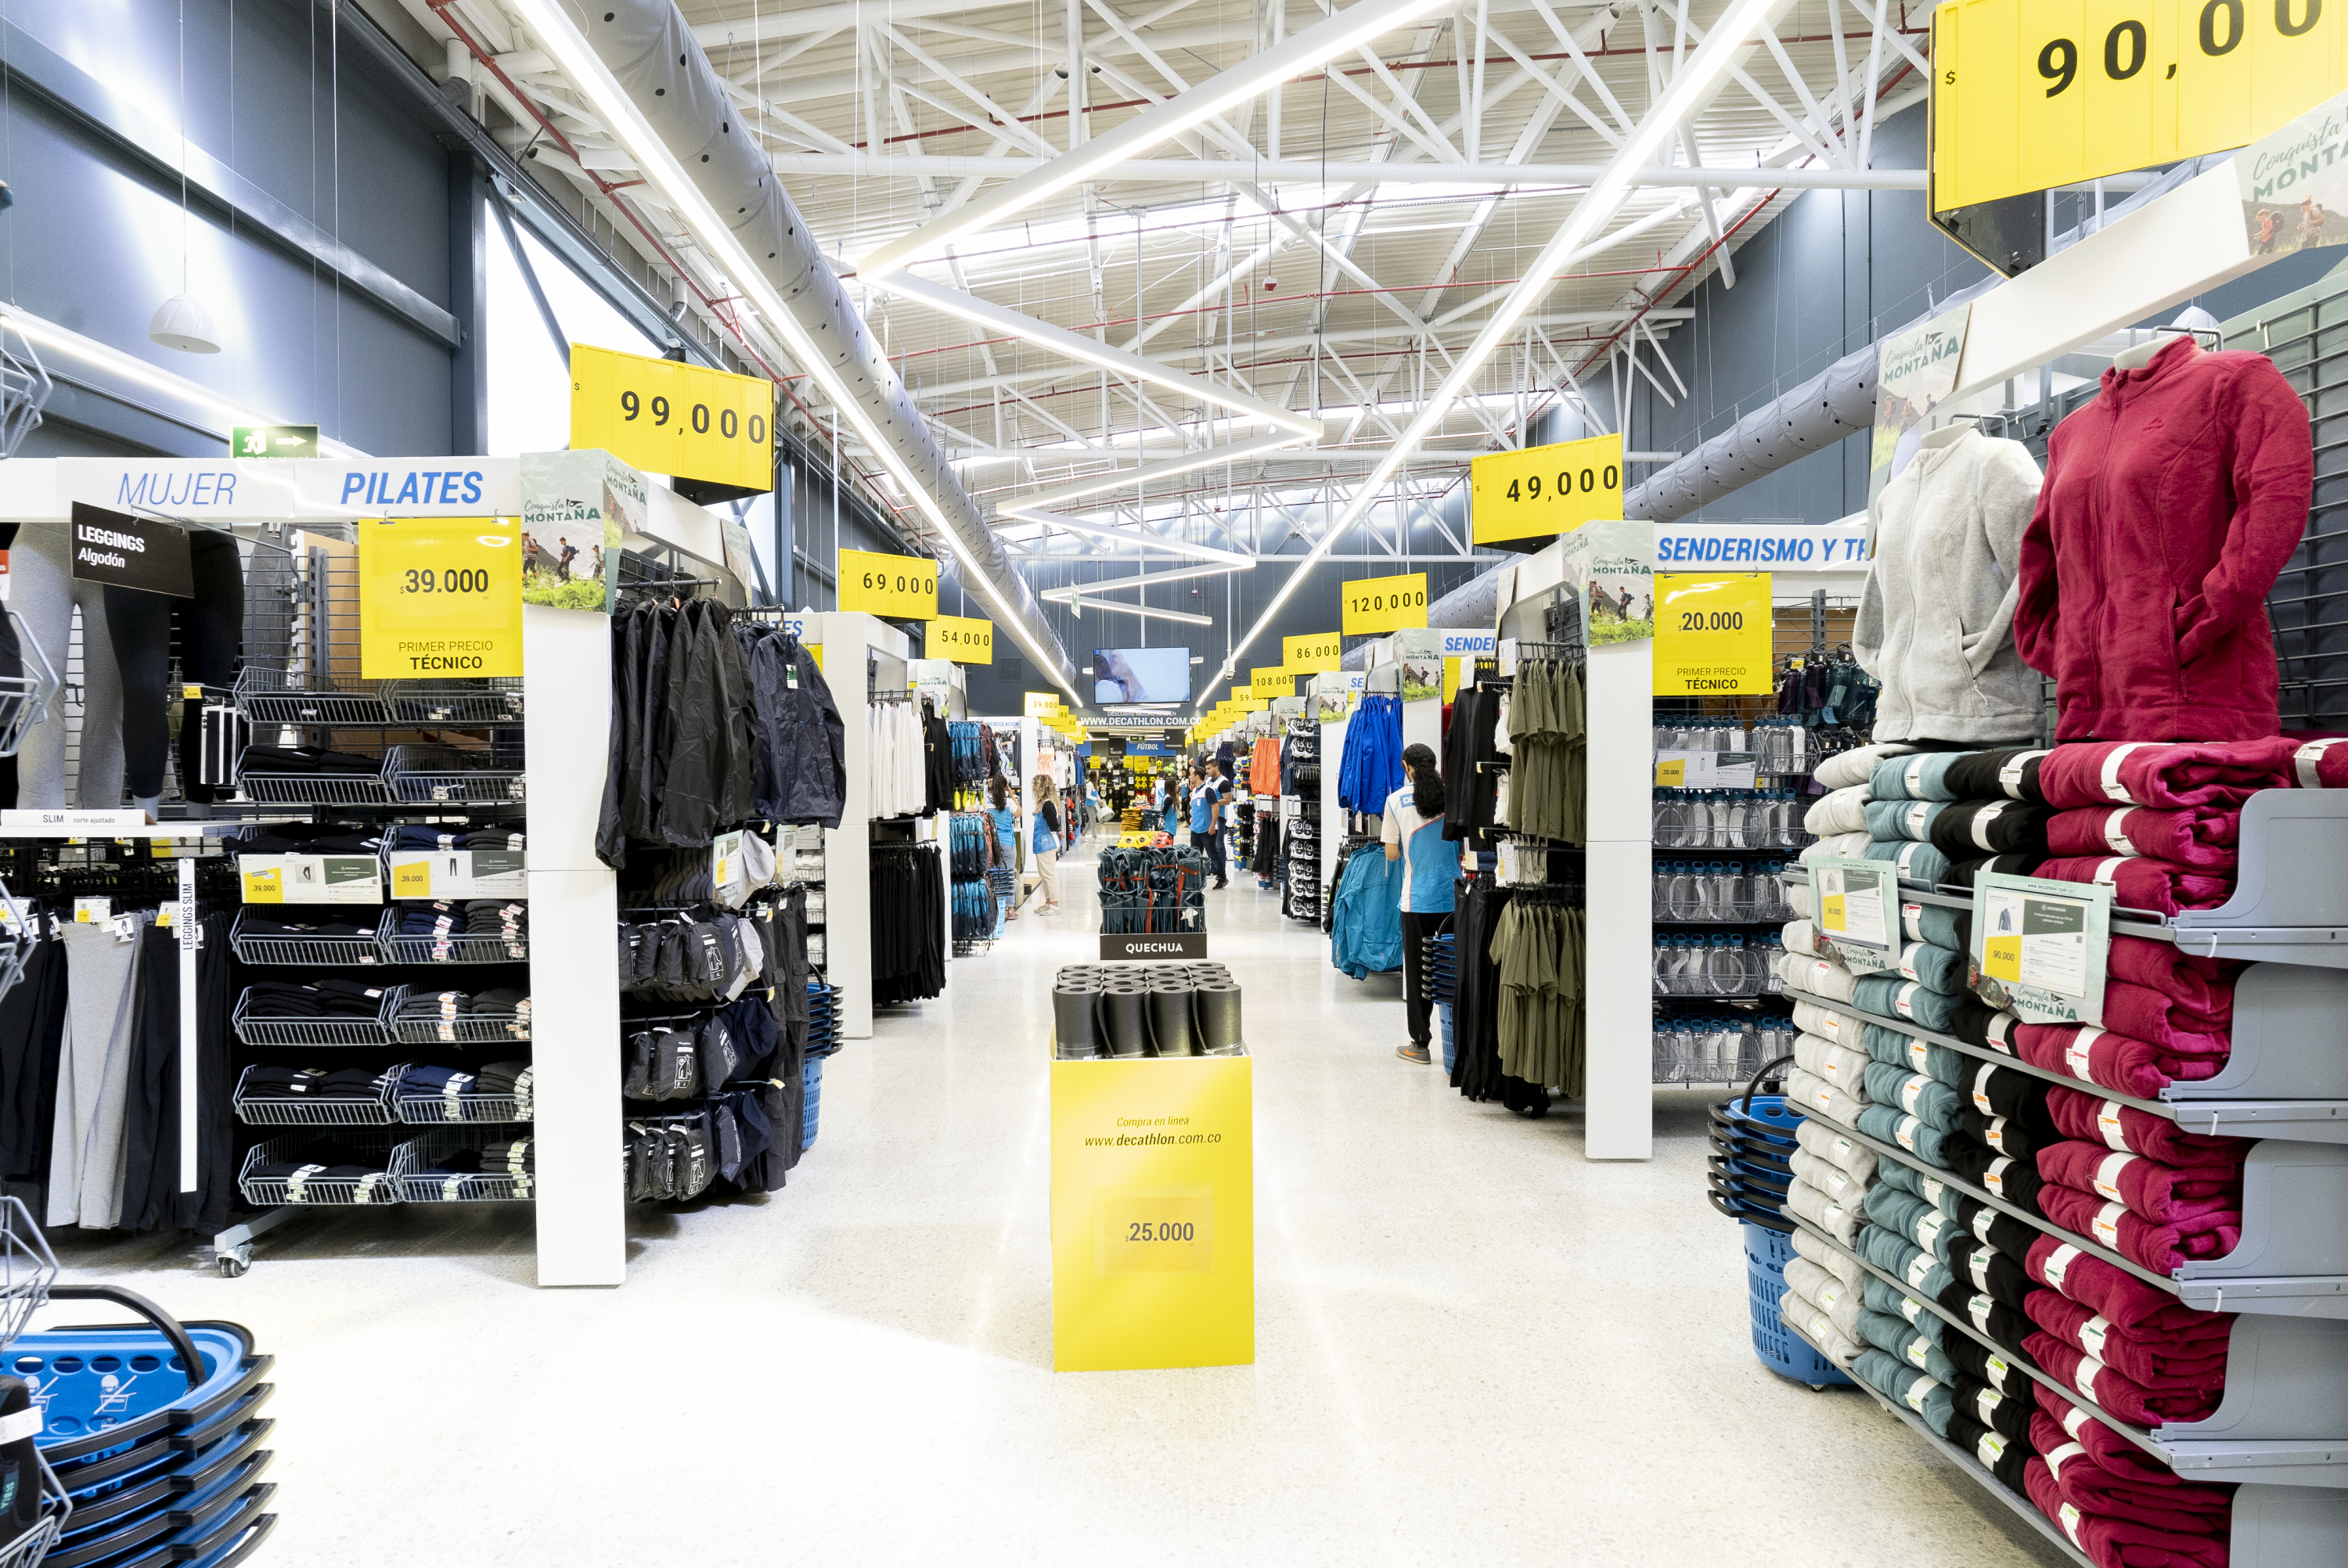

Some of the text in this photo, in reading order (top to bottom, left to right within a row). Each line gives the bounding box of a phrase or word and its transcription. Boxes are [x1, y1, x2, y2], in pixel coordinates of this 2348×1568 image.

[2253, 116, 2343, 181] Conquista
[1884, 336, 1959, 385] MONTAÑA
[1885, 336, 1924, 369] Conquista
[621, 390, 765, 444] 99,000
[117, 472, 237, 505] MUJER
[340, 471, 483, 505] PILATES
[607, 473, 646, 506] MONTAÑA
[1506, 465, 1619, 503] 49,000
[524, 498, 565, 512] Conquista
[524, 505, 601, 523] MONTAÑA
[77, 523, 146, 554] LEGGINGS
[77, 546, 126, 569] Algodón
[1658, 537, 1813, 562] SENDERISMO
[1823, 538, 1838, 562] Y
[1593, 556, 1625, 566] Conquista
[1593, 562, 1652, 575] MONTAÑA
[863, 572, 934, 595] 69,000
[1352, 591, 1424, 613] 120,000
[398, 638, 494, 653] PRIMER PRECIO
[942, 630, 990, 646] 54,000
[1297, 644, 1339, 660] 86,000
[409, 652, 484, 671] TÉCNICO
[1676, 667, 1746, 676] PRIMER PRECIO
[1255, 674, 1294, 687] 108,000
[1350, 678, 1364, 688] SE
[1684, 678, 1738, 690] TÉCNICO
[1033, 700, 1058, 709] 39000
[1081, 717, 1201, 726] WWW.DECATHLON.COM.CO
[1136, 742, 1159, 750] FÚTBOL
[42, 815, 64, 823] SLIM
[90, 816, 116, 825] ajustado
[2027, 883, 2074, 894] www.decathlon.com.co
[182, 883, 193, 950] LEGGINGS SLIM
[1125, 942, 1183, 955] QUECHUA
[1846, 955, 1887, 970] MONTAÑA
[2018, 985, 2050, 1002] Conquista
[2017, 998, 2078, 1021] MONTAÑA
[1117, 1115, 1190, 1128] Compra en línea
[1084, 1132, 1222, 1147] www.decathlon.com.co
